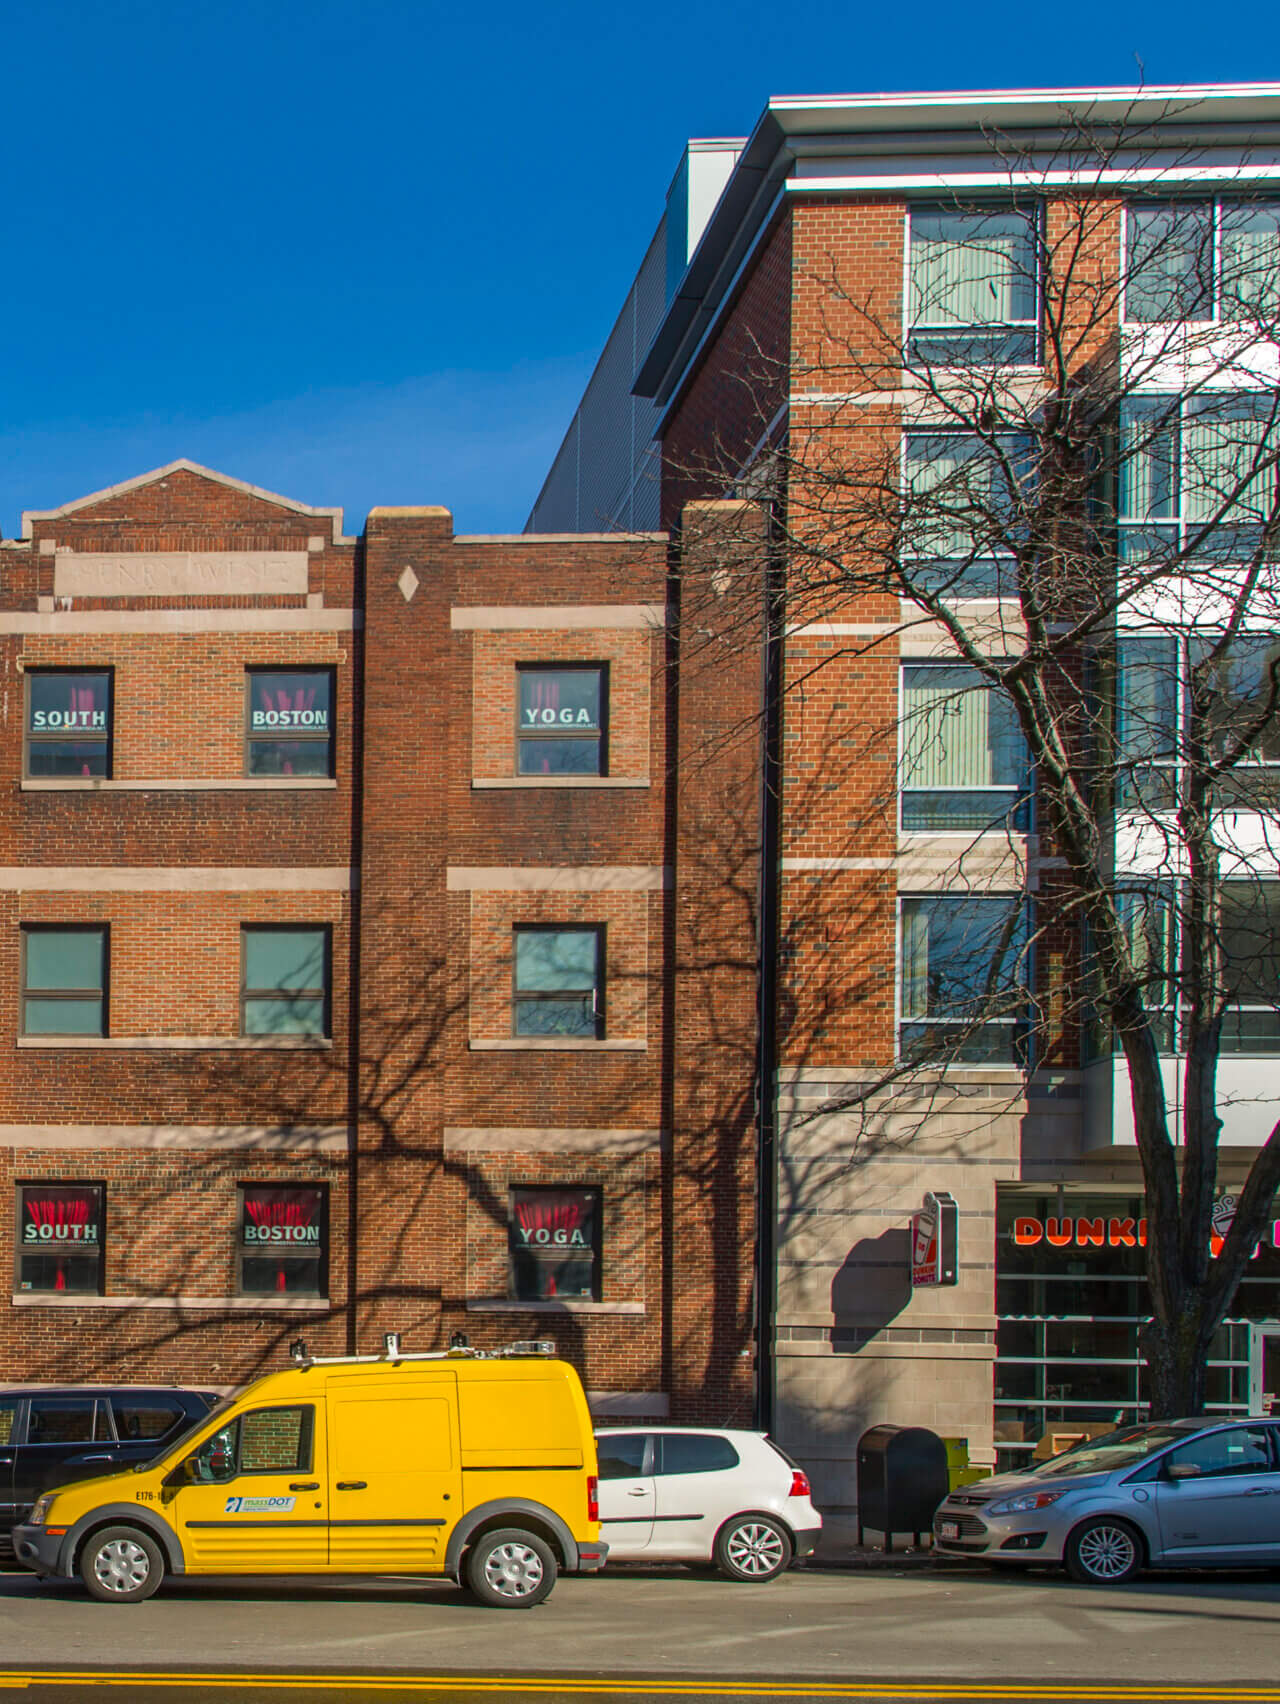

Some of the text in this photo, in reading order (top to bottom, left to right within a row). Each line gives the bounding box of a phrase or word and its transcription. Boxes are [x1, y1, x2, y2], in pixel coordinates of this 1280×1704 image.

[33, 710, 105, 726] SOUTH
[252, 710, 327, 725] BOSTON
[525, 708, 590, 723] YOGA
[25, 1224, 97, 1239] SOUTH
[244, 1226, 320, 1240] BOSTON
[520, 1228, 585, 1243] YOGA
[1014, 1217, 1148, 1247] DUNKI
